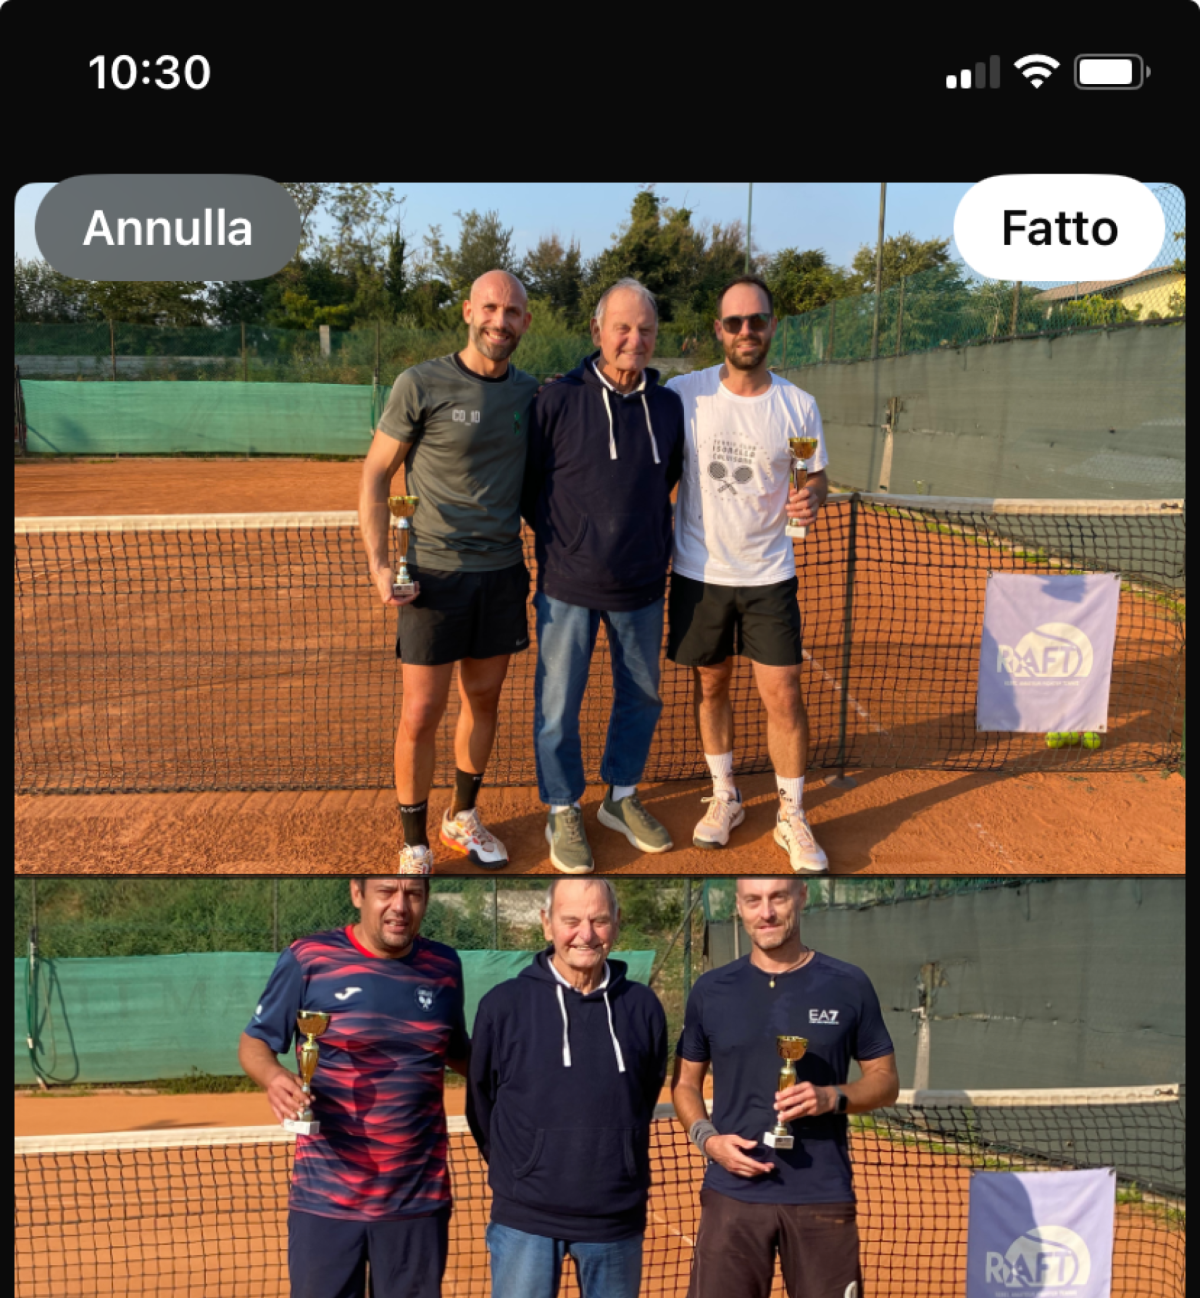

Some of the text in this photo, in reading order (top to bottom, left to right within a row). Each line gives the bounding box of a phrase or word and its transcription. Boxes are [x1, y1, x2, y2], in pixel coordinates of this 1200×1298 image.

[996, 644, 1078, 674] RAFT
[809, 1009, 839, 1021] EA7
[985, 1251, 1073, 1284] RAFT
